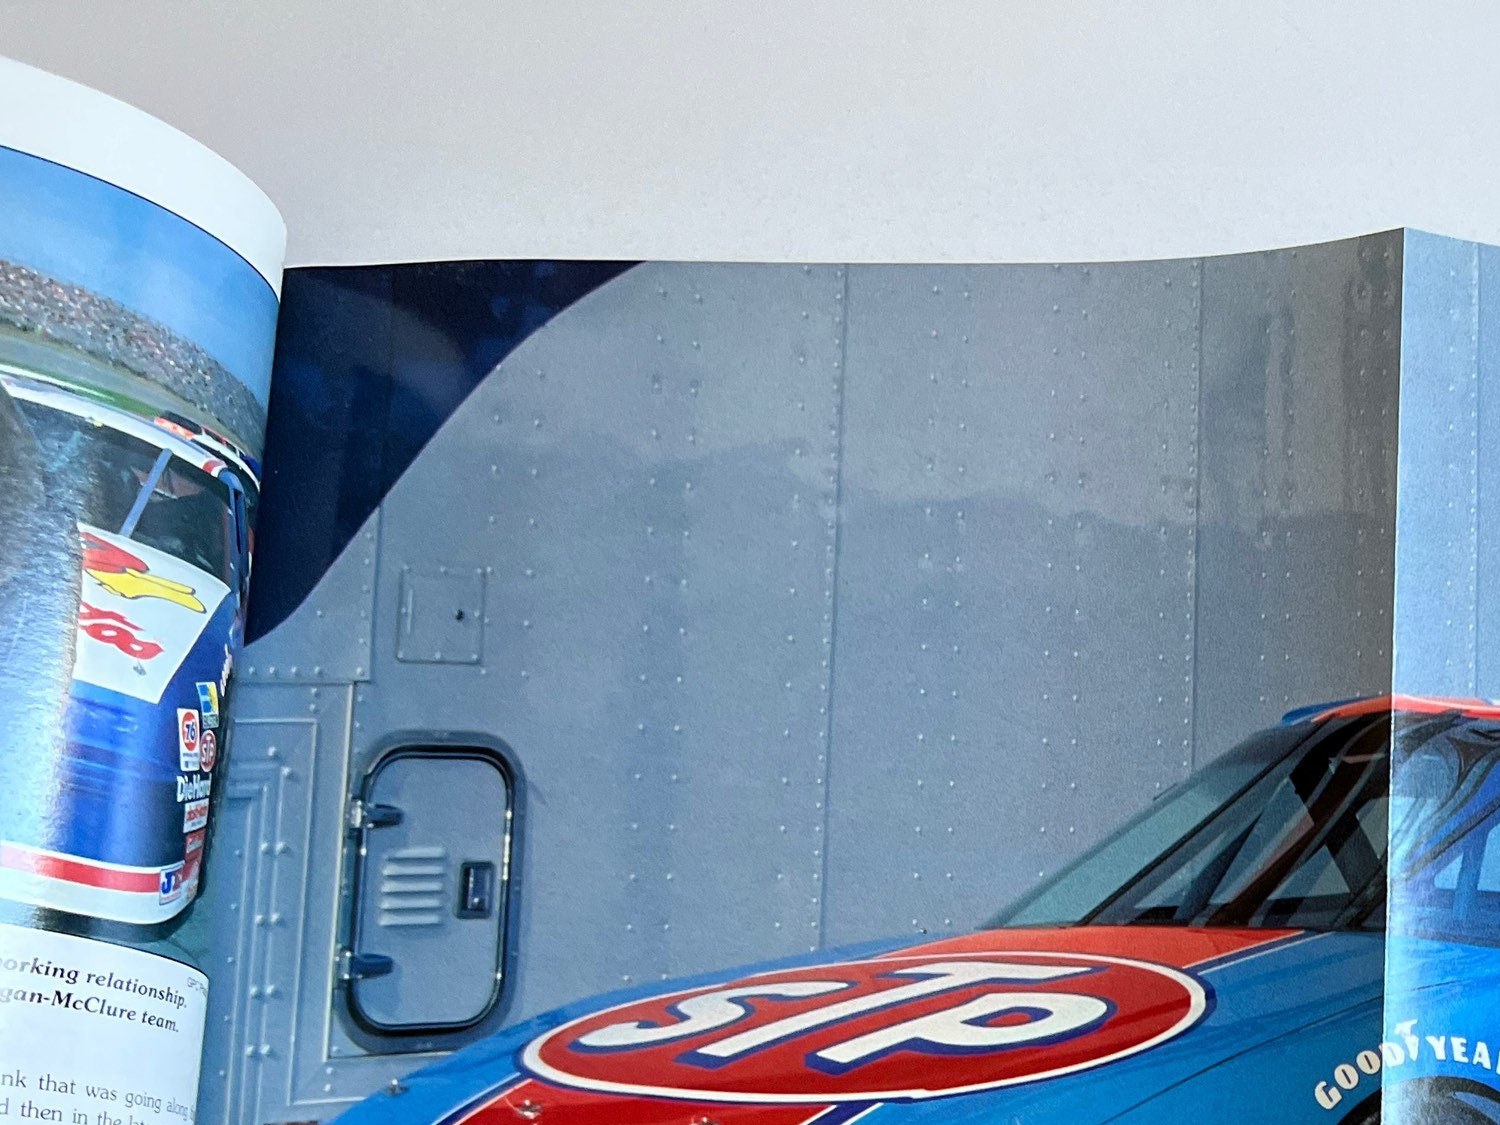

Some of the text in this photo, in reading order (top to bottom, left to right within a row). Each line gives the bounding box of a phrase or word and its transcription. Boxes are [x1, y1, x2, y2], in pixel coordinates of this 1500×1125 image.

[86, 972, 188, 1009] relationship.
[141, 1010, 179, 1033] team.
[573, 961, 1110, 1066] STP
[20, 1100, 63, 1123] then
[72, 1108, 88, 1125] in
[39, 1073, 76, 1096] that
[86, 1085, 118, 1102] was
[125, 1092, 162, 1115] going
[166, 1097, 189, 1122] along
